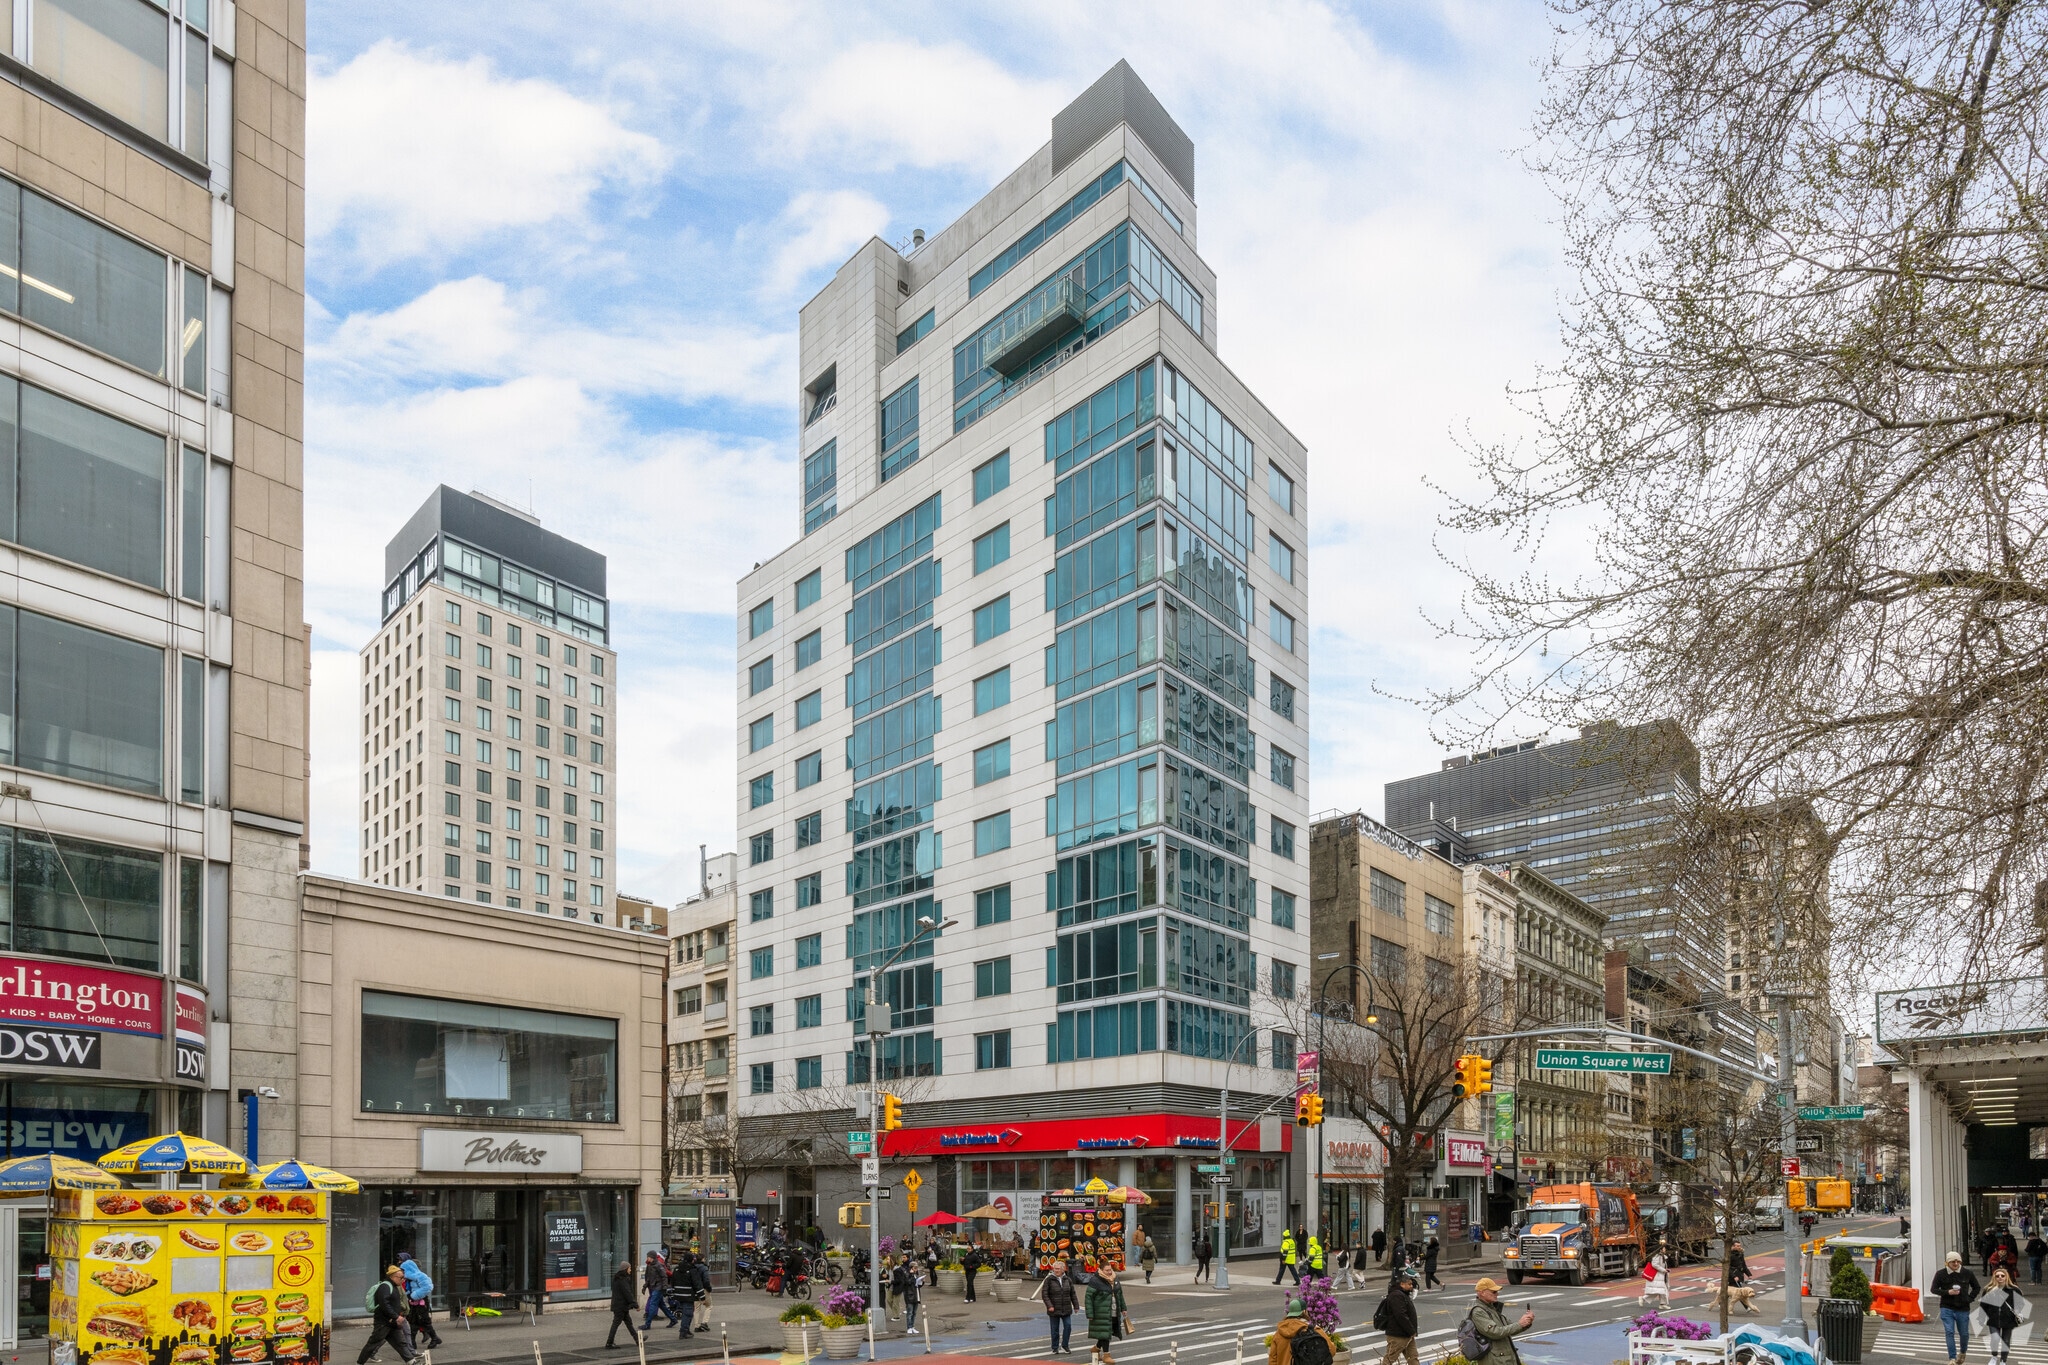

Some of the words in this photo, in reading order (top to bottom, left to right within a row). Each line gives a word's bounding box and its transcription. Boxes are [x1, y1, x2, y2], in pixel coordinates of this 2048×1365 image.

[9, 1008, 36, 1017] KIDS
[49, 1011, 76, 1021] BABY
[87, 1015, 116, 1025] HOME
[125, 1019, 152, 1030] COATS
[0, 1029, 96, 1064] DSW
[1541, 1054, 1578, 1065] Union
[1582, 1055, 1629, 1068] Square
[1632, 1057, 1665, 1069] West
[1828, 1106, 1861, 1115] SQUARE
[464, 1137, 547, 1166] Bolton's
[1328, 1141, 1372, 1158] POPEYES
[99, 1160, 135, 1169] SABRETT
[191, 1160, 242, 1171] SABRETT
[866, 1162, 874, 1170] NO
[57, 1178, 117, 1189] SABRETT
